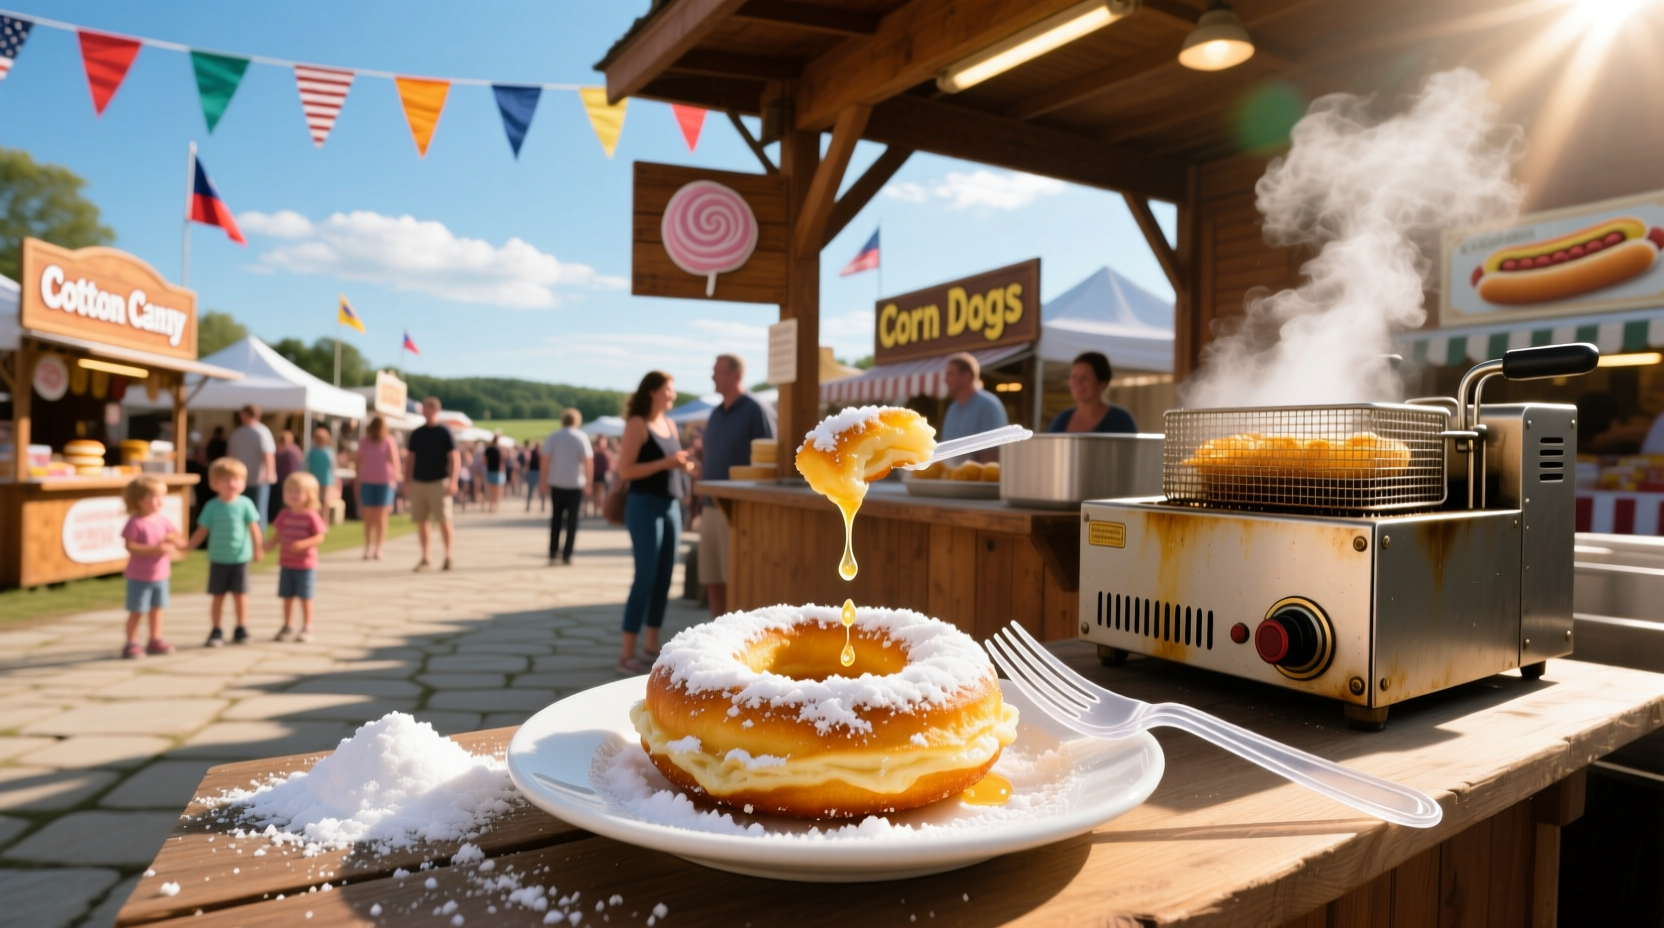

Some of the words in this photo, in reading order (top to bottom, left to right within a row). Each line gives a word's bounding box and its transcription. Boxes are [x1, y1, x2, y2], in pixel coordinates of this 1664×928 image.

[41, 264, 126, 325] Cotton
[879, 303, 941, 349] Corn
[947, 282, 1024, 341] Dogs
